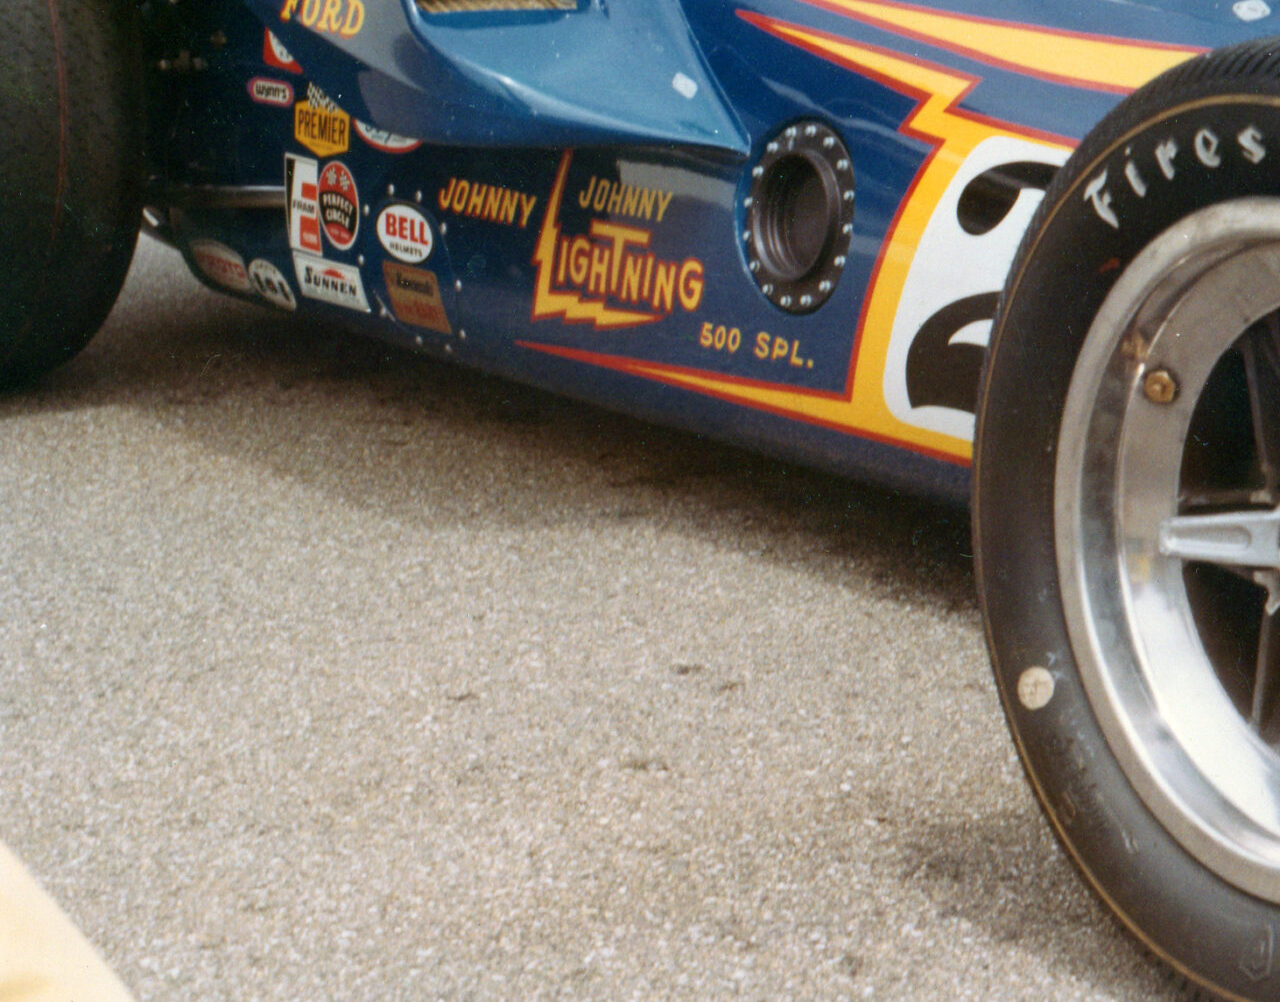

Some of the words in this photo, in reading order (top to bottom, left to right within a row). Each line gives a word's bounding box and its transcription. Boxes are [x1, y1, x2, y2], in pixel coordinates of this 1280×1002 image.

[298, 109, 346, 147] PREMIER
[438, 177, 536, 229] JOHNNY
[579, 175, 673, 222] JOHNNY
[385, 212, 430, 247] BELL
[304, 266, 358, 297] SUNNEN
[700, 321, 741, 353] 500
[754, 331, 813, 369] SPL.
